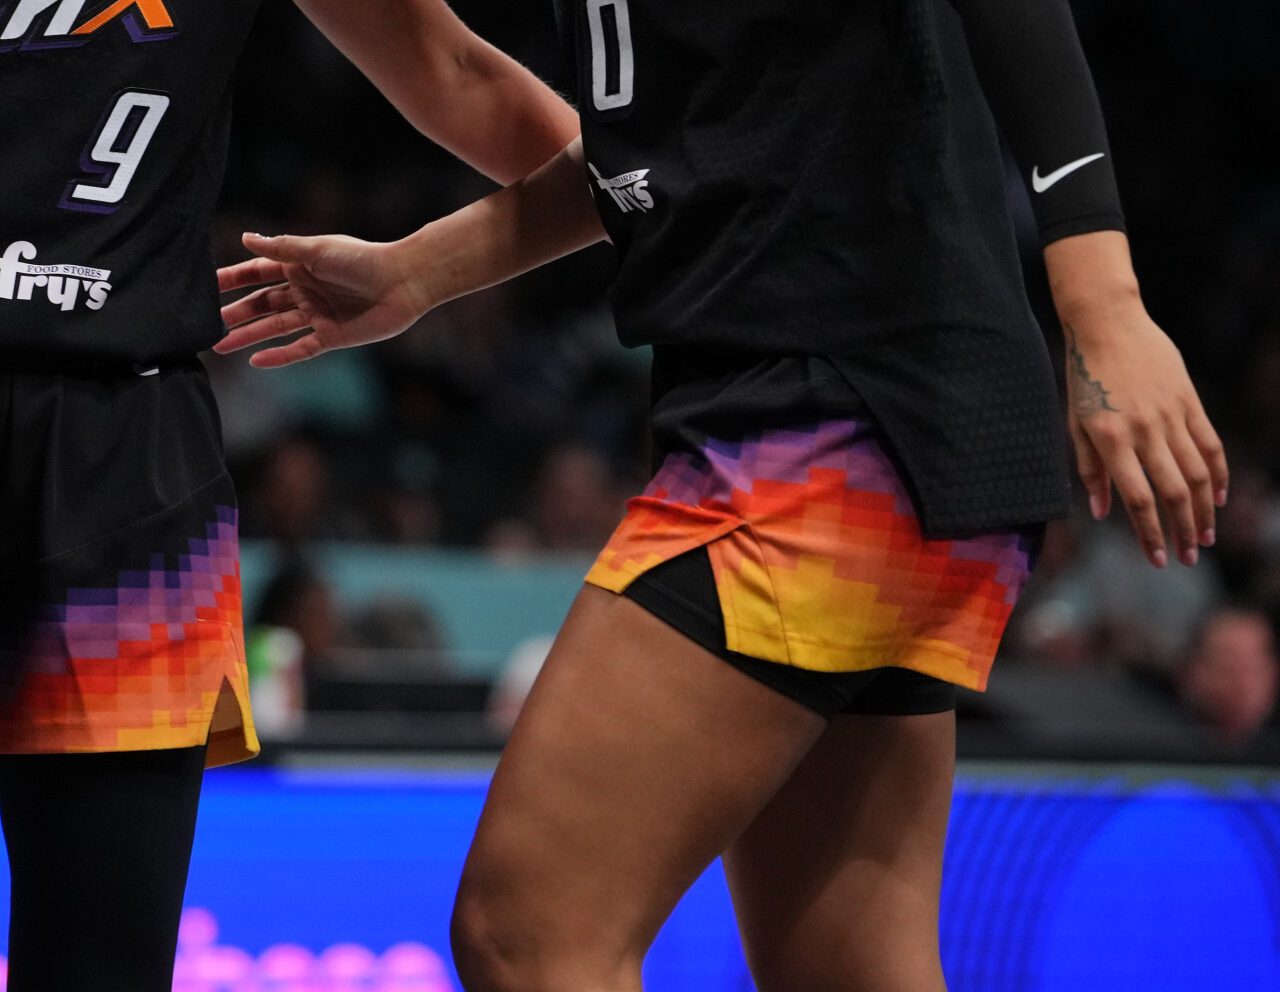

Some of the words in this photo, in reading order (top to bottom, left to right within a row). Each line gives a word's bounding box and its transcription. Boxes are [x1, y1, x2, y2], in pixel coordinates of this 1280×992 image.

[71, 91, 170, 204] 9
[27, 264, 59, 274] FOOD
[63, 265, 102, 279] STORES
